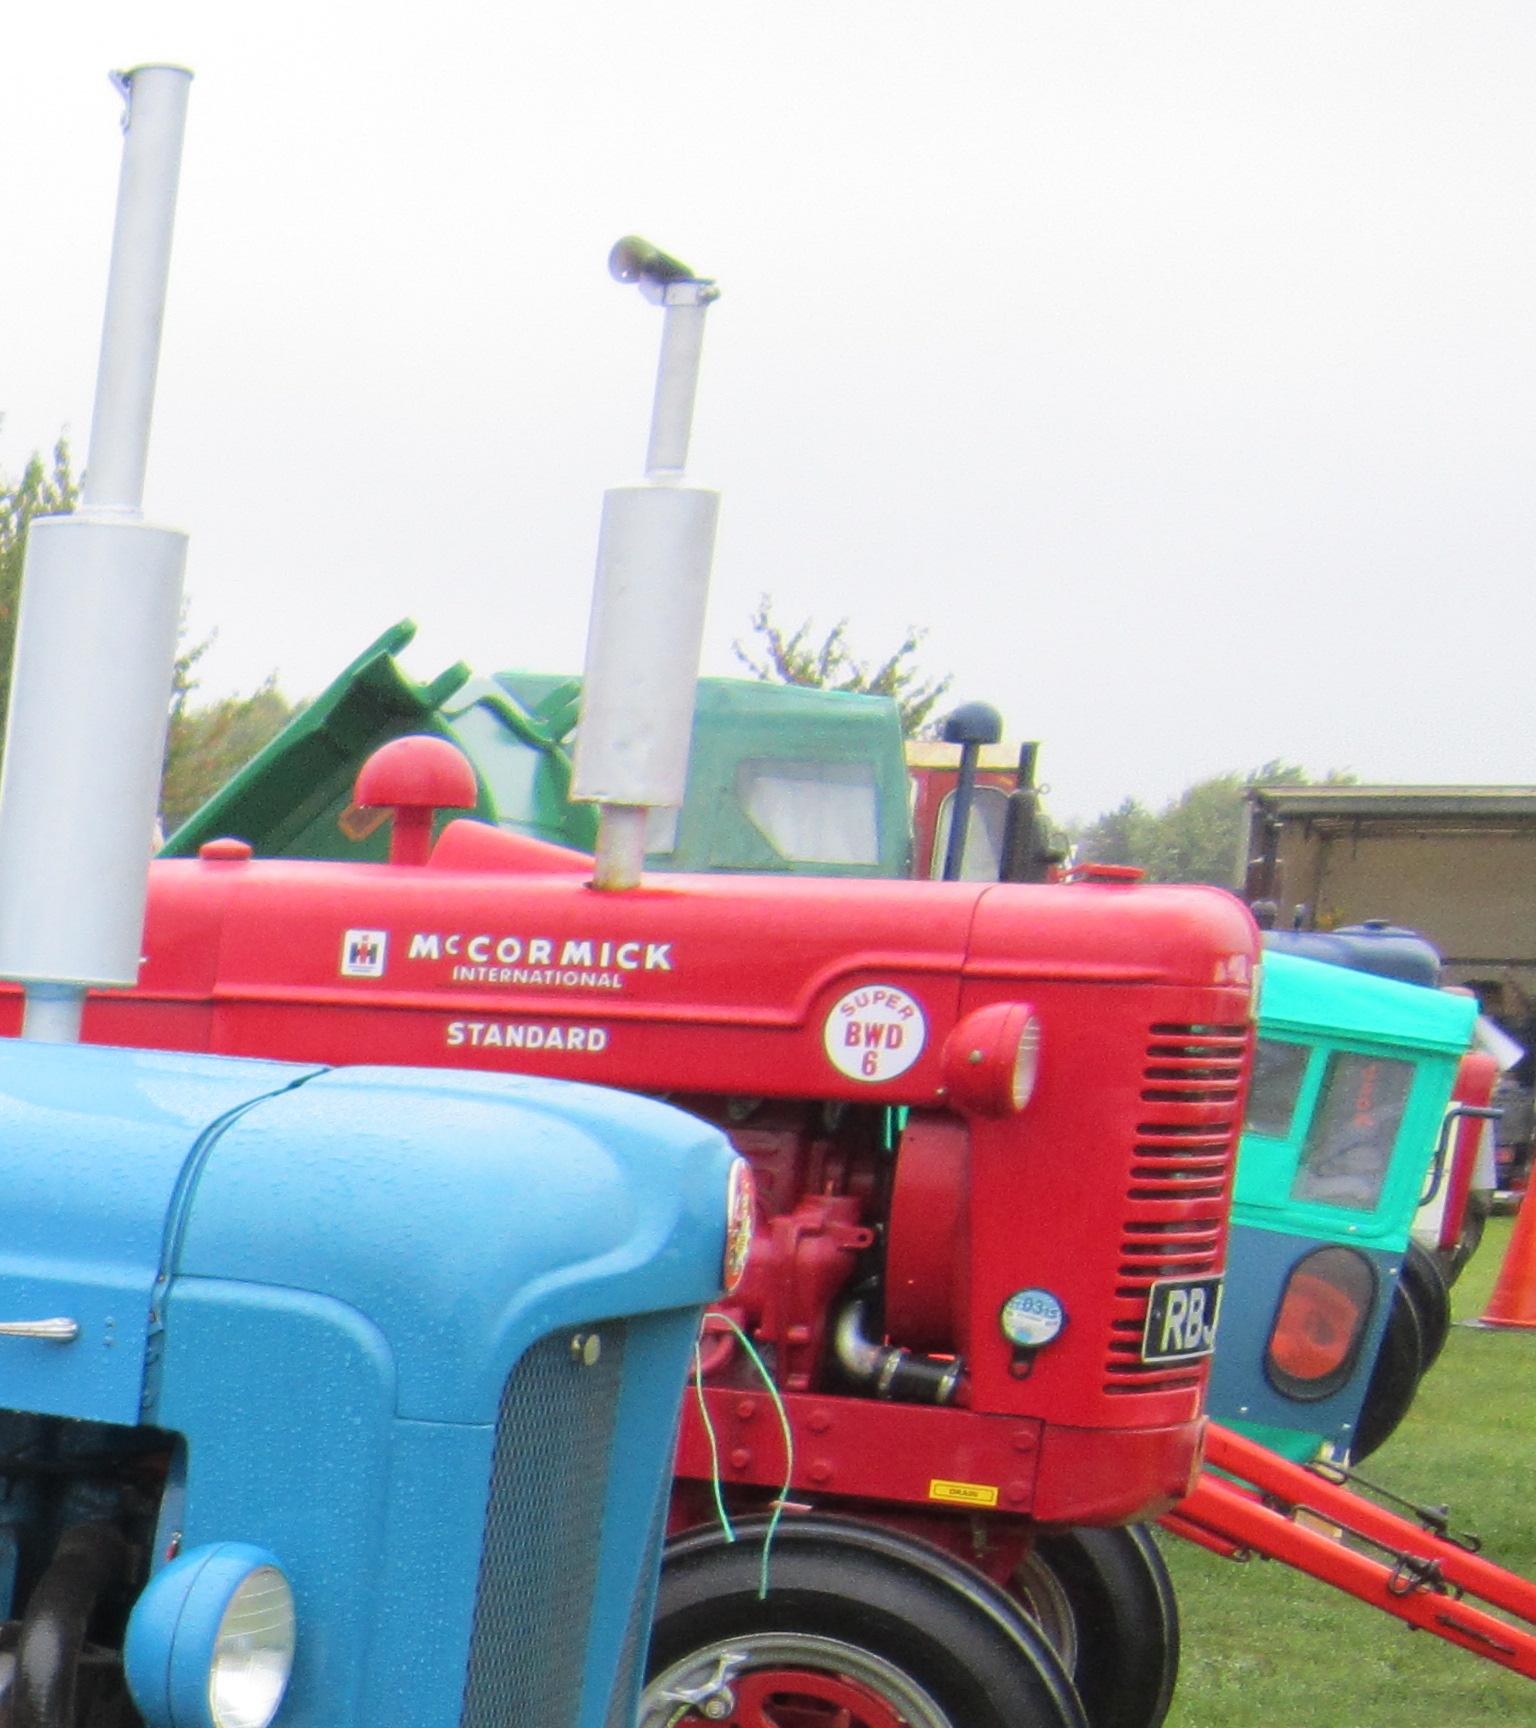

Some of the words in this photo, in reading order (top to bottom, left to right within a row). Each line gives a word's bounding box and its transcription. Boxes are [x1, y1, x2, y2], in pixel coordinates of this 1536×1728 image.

[451, 965, 624, 989] INTERNATIONAL
[840, 990, 915, 1021] SUPER
[446, 1021, 609, 1051] STANDARD
[844, 1021, 904, 1050] BWD
[861, 1050, 879, 1077] 6
